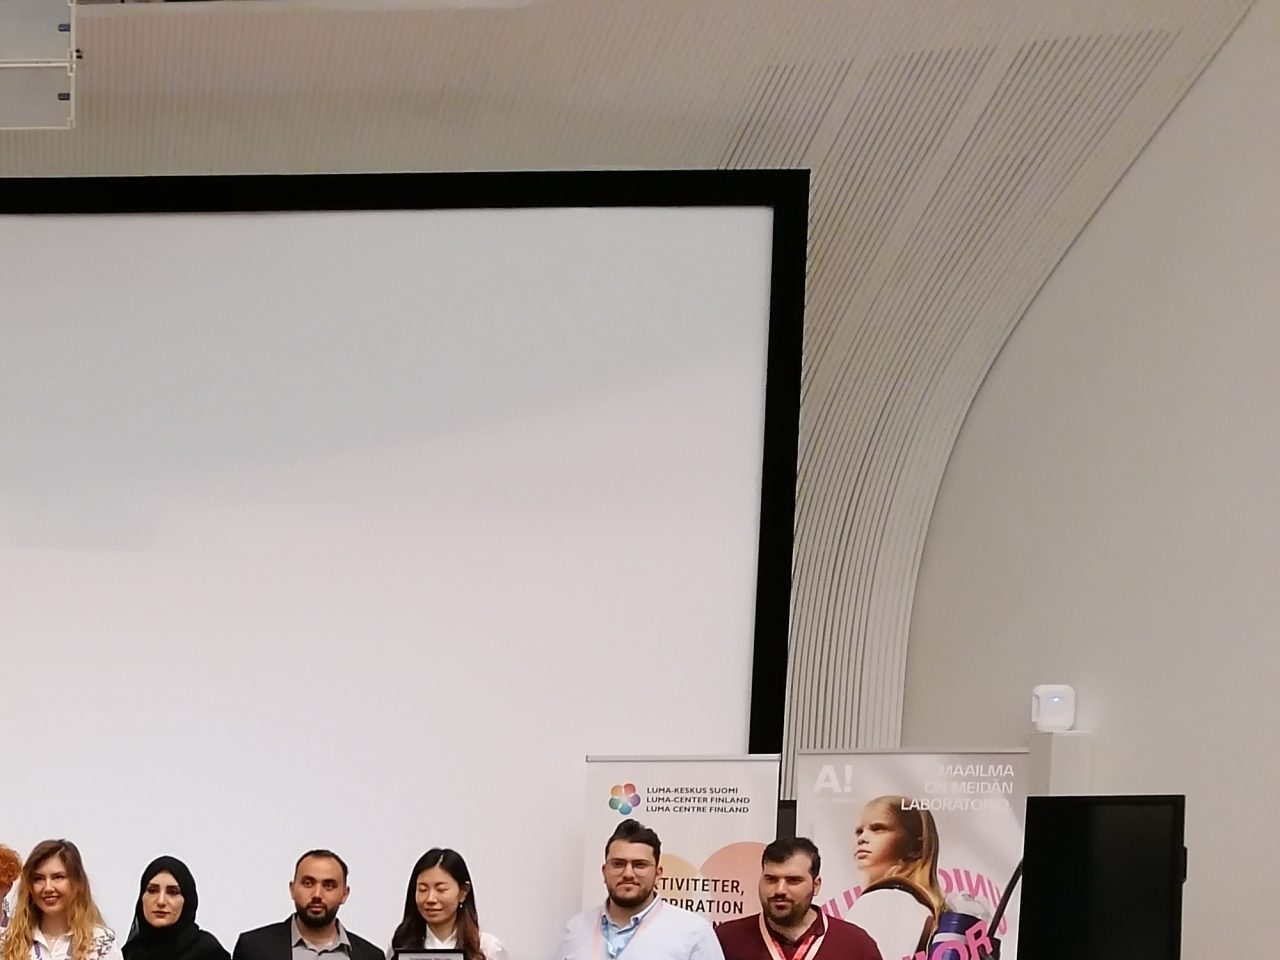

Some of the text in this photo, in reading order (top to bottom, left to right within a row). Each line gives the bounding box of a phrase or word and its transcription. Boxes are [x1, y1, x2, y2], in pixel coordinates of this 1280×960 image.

[938, 764, 1015, 777] MAAILMA
[812, 764, 854, 793] A!
[709, 787, 739, 795] SUOMI
[951, 779, 1013, 794] MEIDÄN
[646, 796, 708, 804] LUMA-CENTER
[645, 805, 671, 813] LUMA
[709, 806, 750, 814] FINLAND
